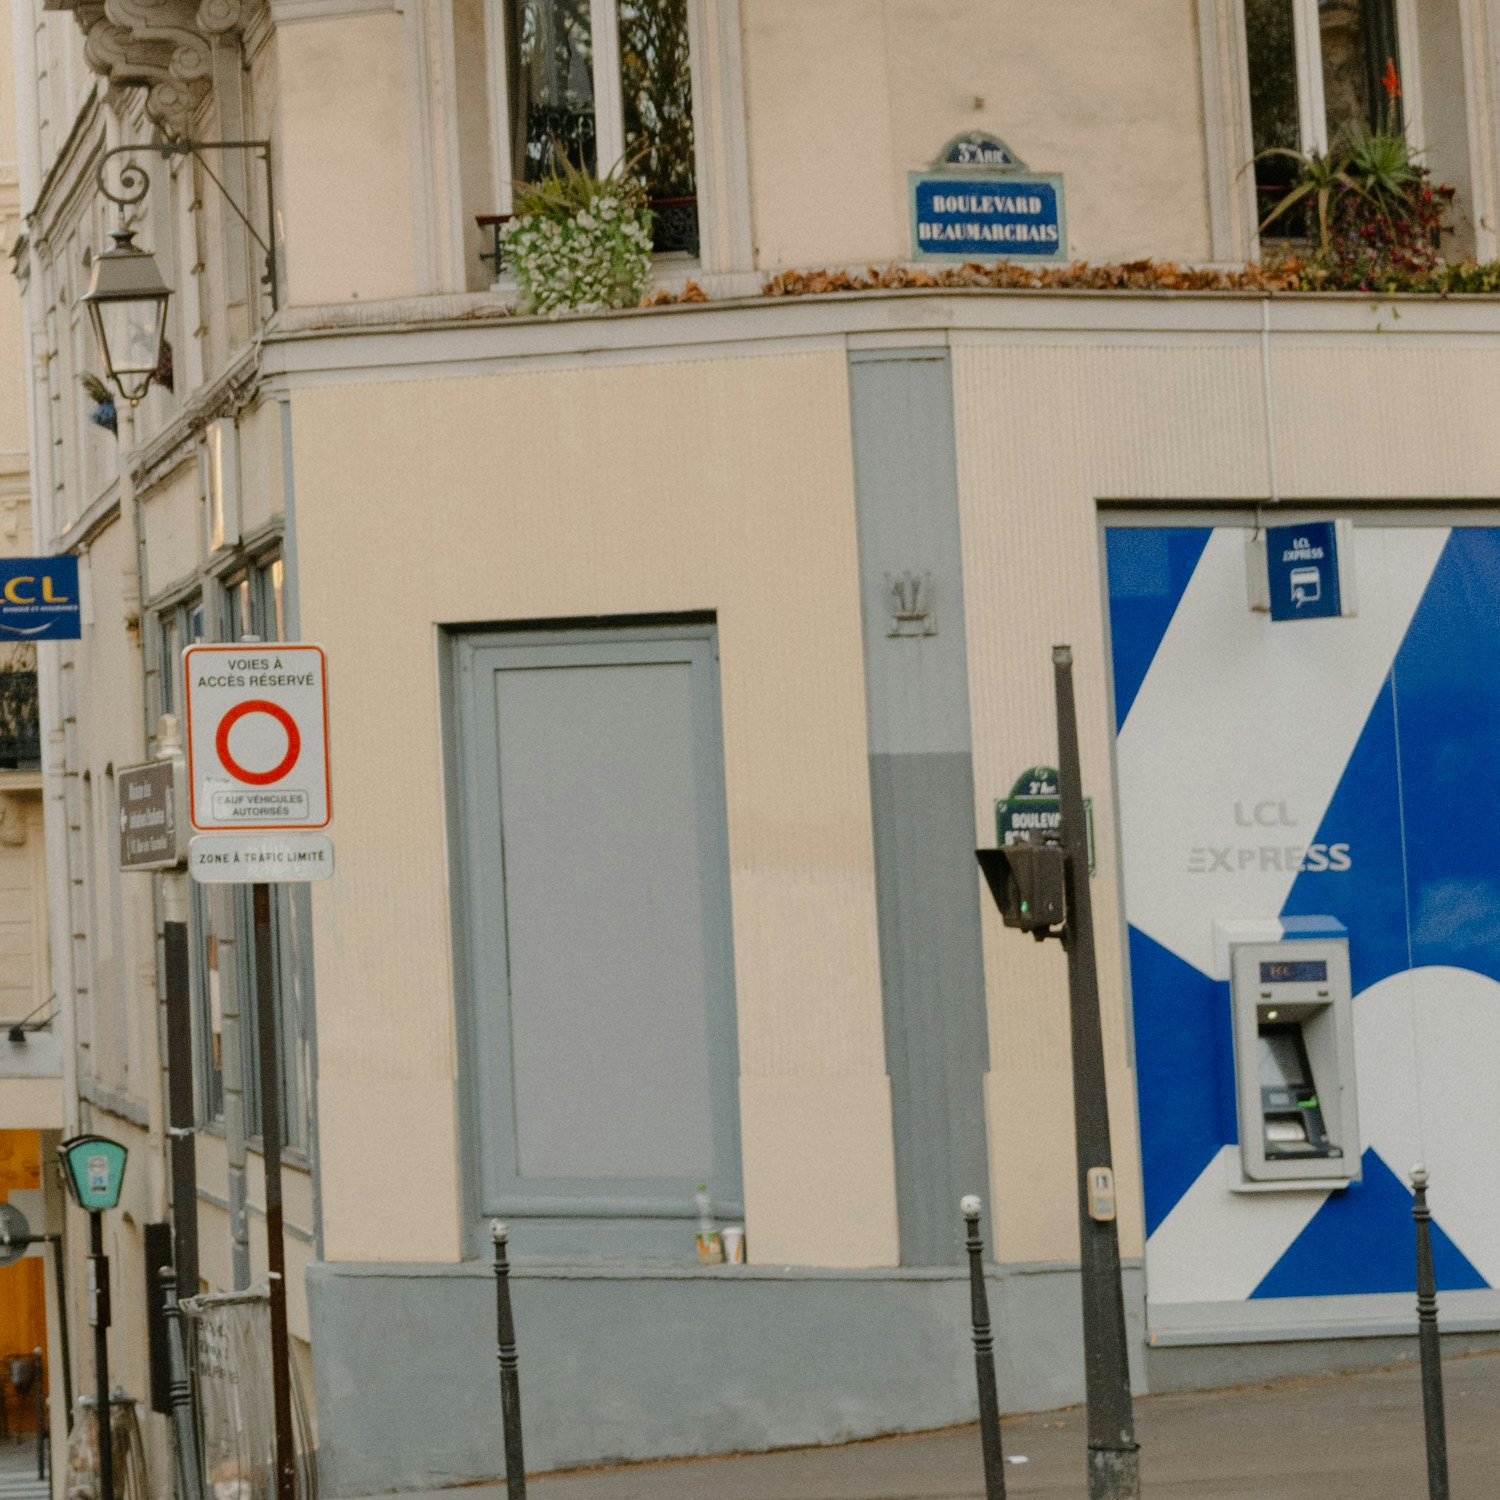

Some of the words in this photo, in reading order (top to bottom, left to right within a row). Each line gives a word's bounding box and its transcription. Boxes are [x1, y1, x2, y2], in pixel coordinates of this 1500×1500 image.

[932, 195, 1042, 214] BOULEVARD
[918, 222, 1058, 242] BEAUMARCHAIS
[1293, 537, 1311, 549] LCL
[1282, 547, 1325, 562] EXPRESS
[228, 658, 269, 670] VOIES
[273, 655, 283, 670] À
[198, 673, 245, 688] ACCÈS
[249, 671, 315, 687] RÉSERVÉ
[247, 793, 303, 804] VÉHICULES
[232, 806, 289, 816] AUTORISÉS
[1234, 801, 1297, 827] LCL
[200, 853, 229, 864] ZONE
[233, 851, 240, 864] À
[244, 852, 283, 863] TRAFIC
[287, 850, 325, 862] LIMITÉ
[1187, 843, 1351, 873] EXPRESS
